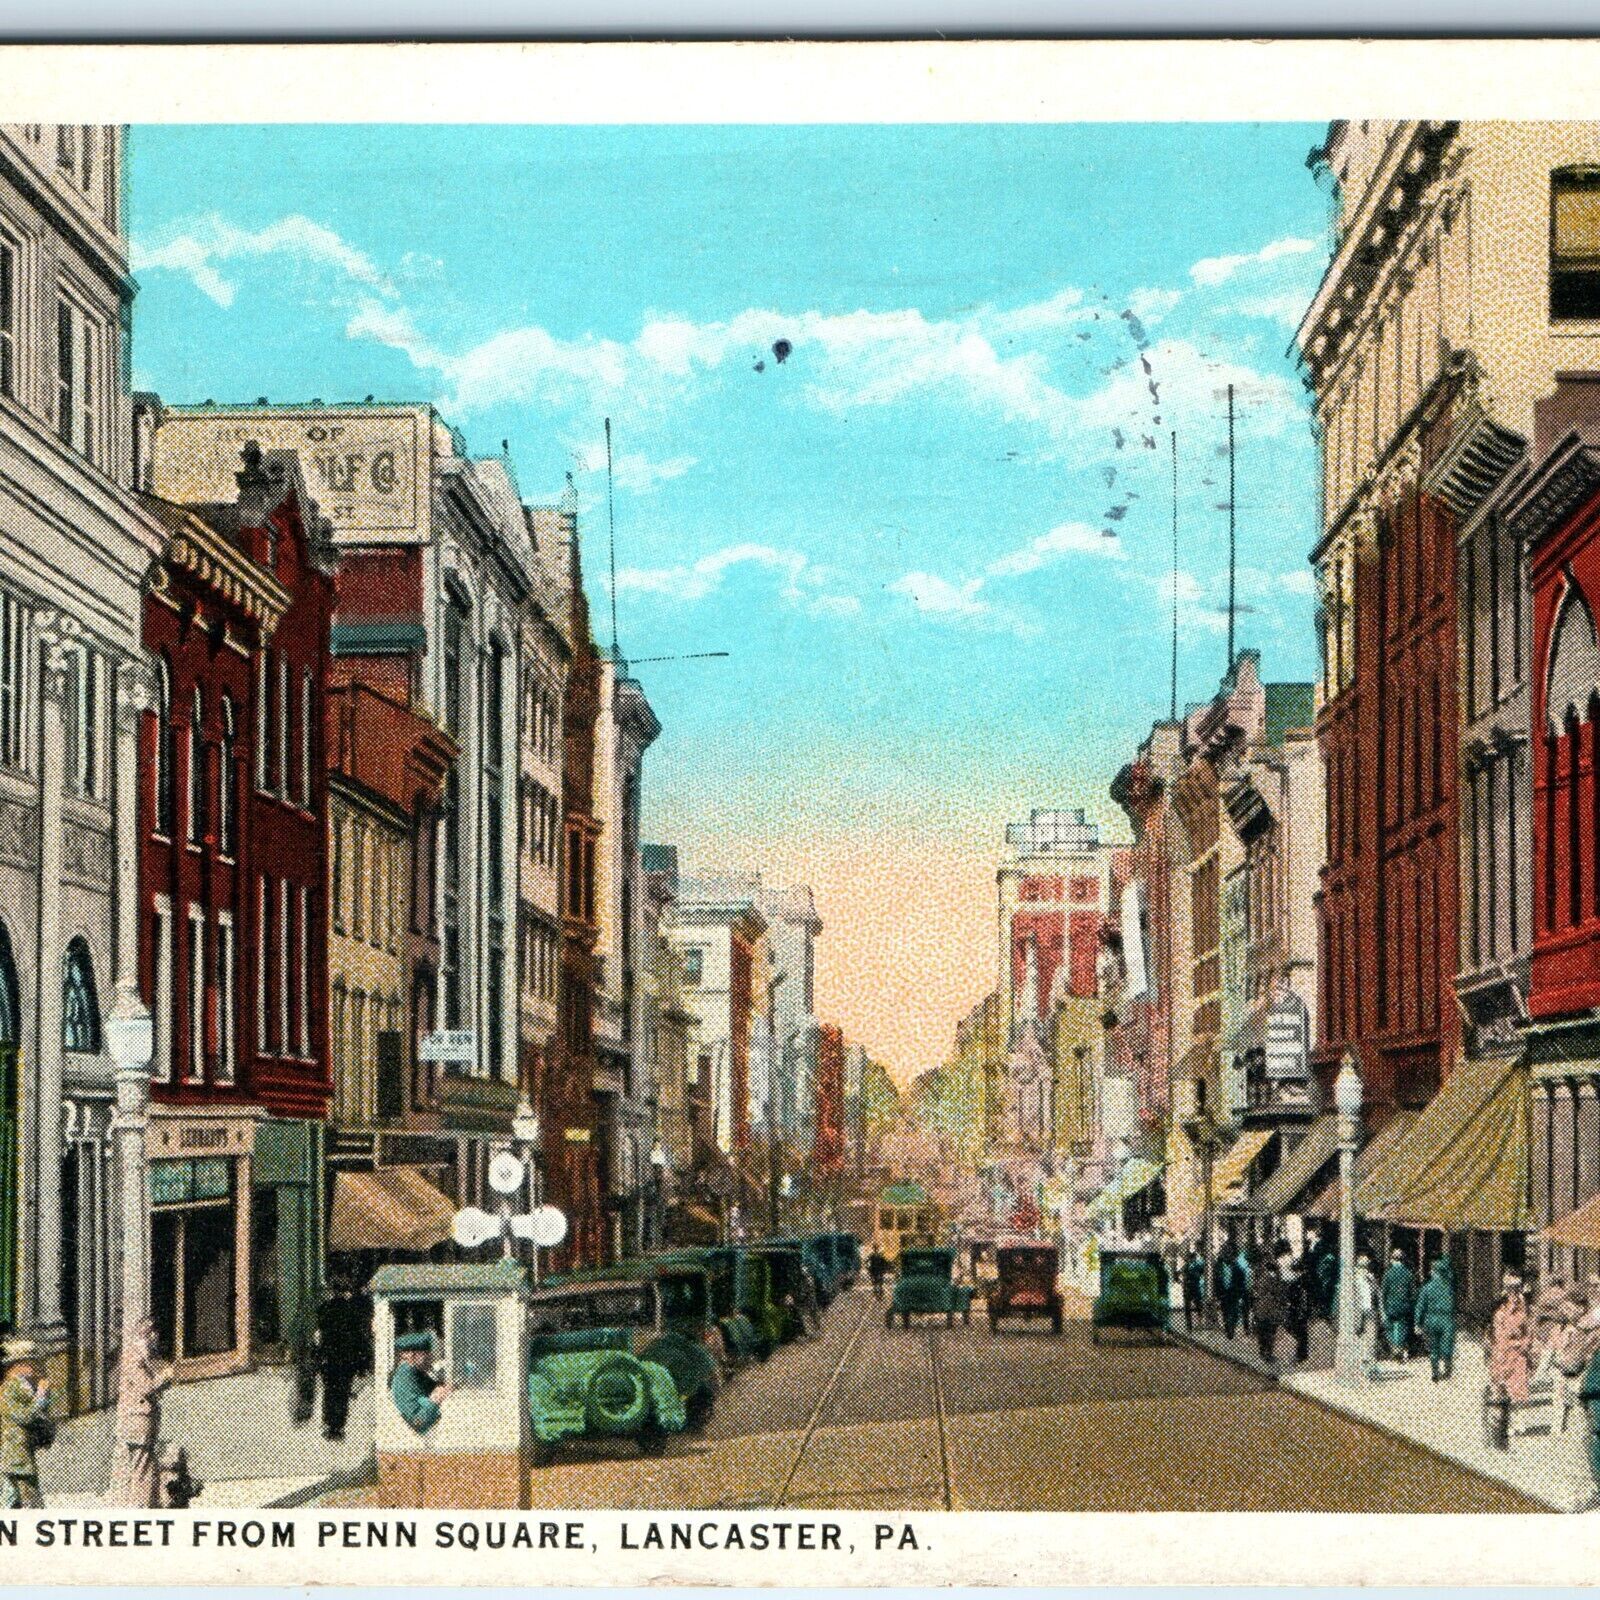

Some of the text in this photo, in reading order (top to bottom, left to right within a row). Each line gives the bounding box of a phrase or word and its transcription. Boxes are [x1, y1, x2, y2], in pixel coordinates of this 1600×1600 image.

[0, 1519, 932, 1553] N STREET FROM PENN SQUARE, LANCASTER, PA.
